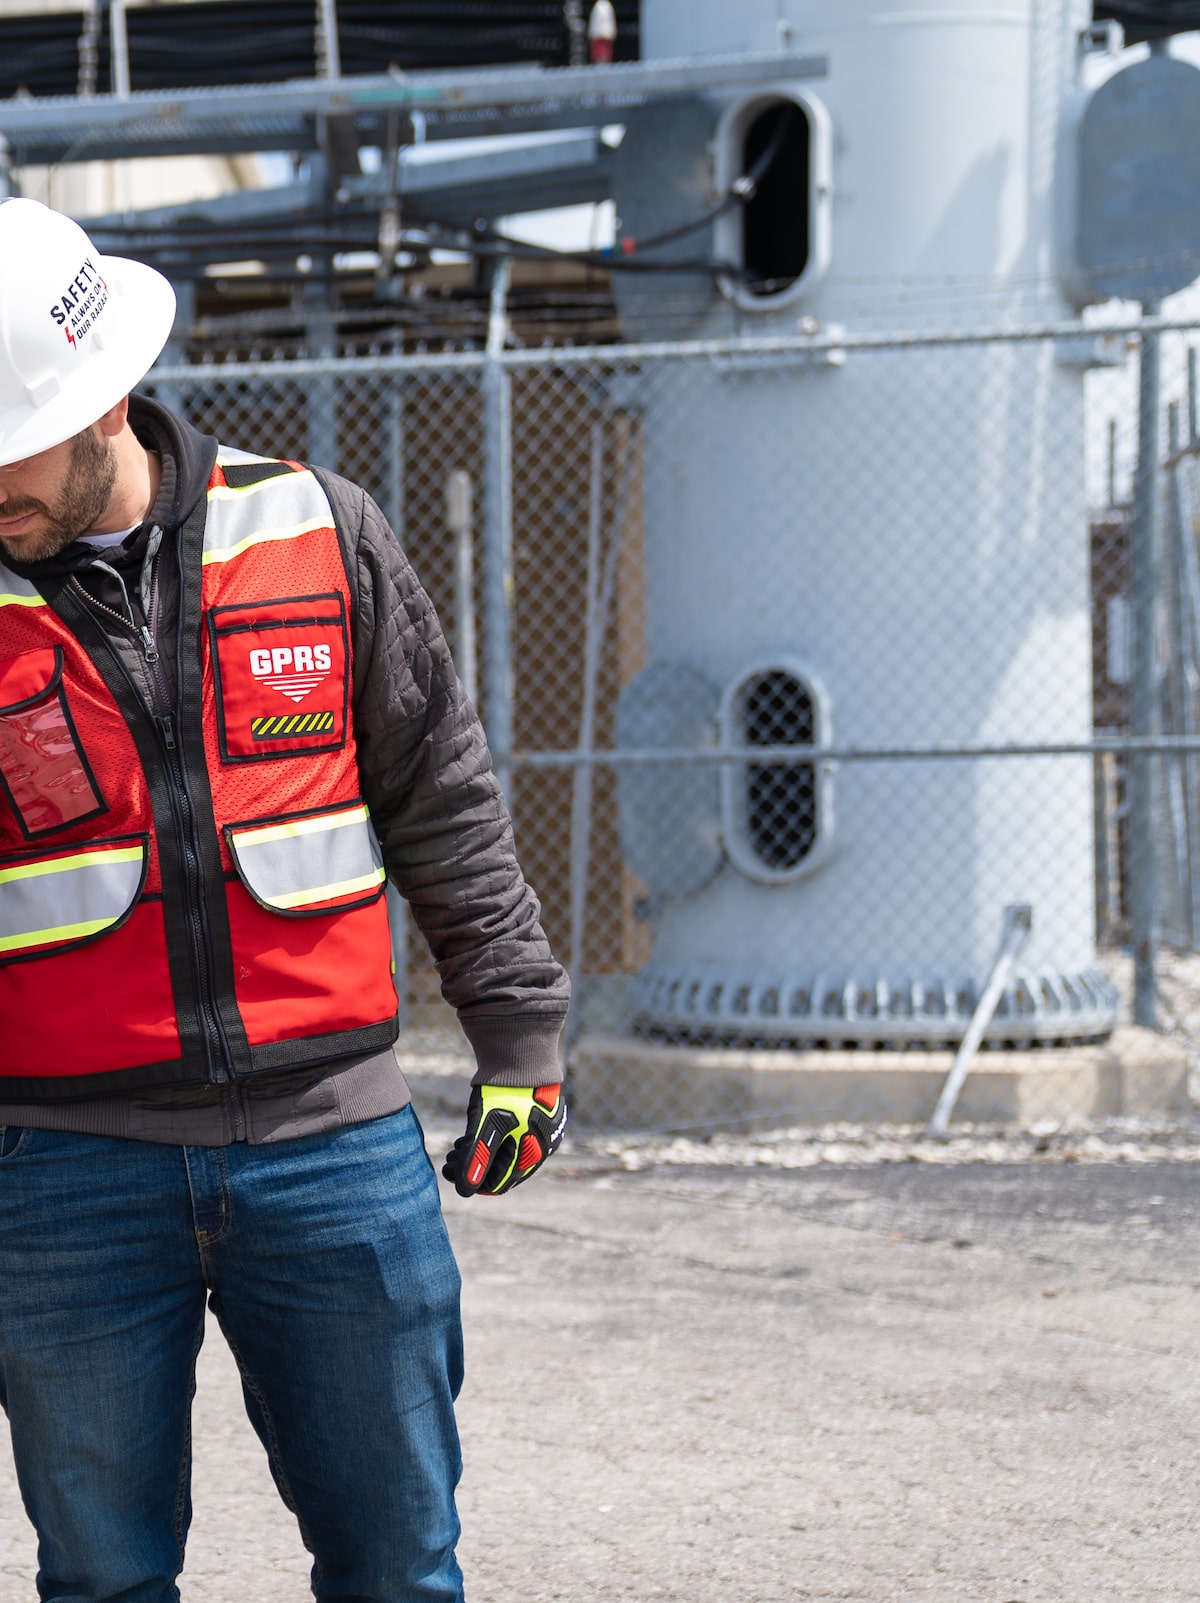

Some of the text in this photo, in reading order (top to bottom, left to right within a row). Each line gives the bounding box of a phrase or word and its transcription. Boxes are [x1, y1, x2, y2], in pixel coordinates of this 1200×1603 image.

[50, 257, 97, 325] SAFETY
[70, 282, 102, 328] ALWAYS ON
[76, 293, 108, 340] OUR RADAR
[249, 644, 332, 676] GPRS
